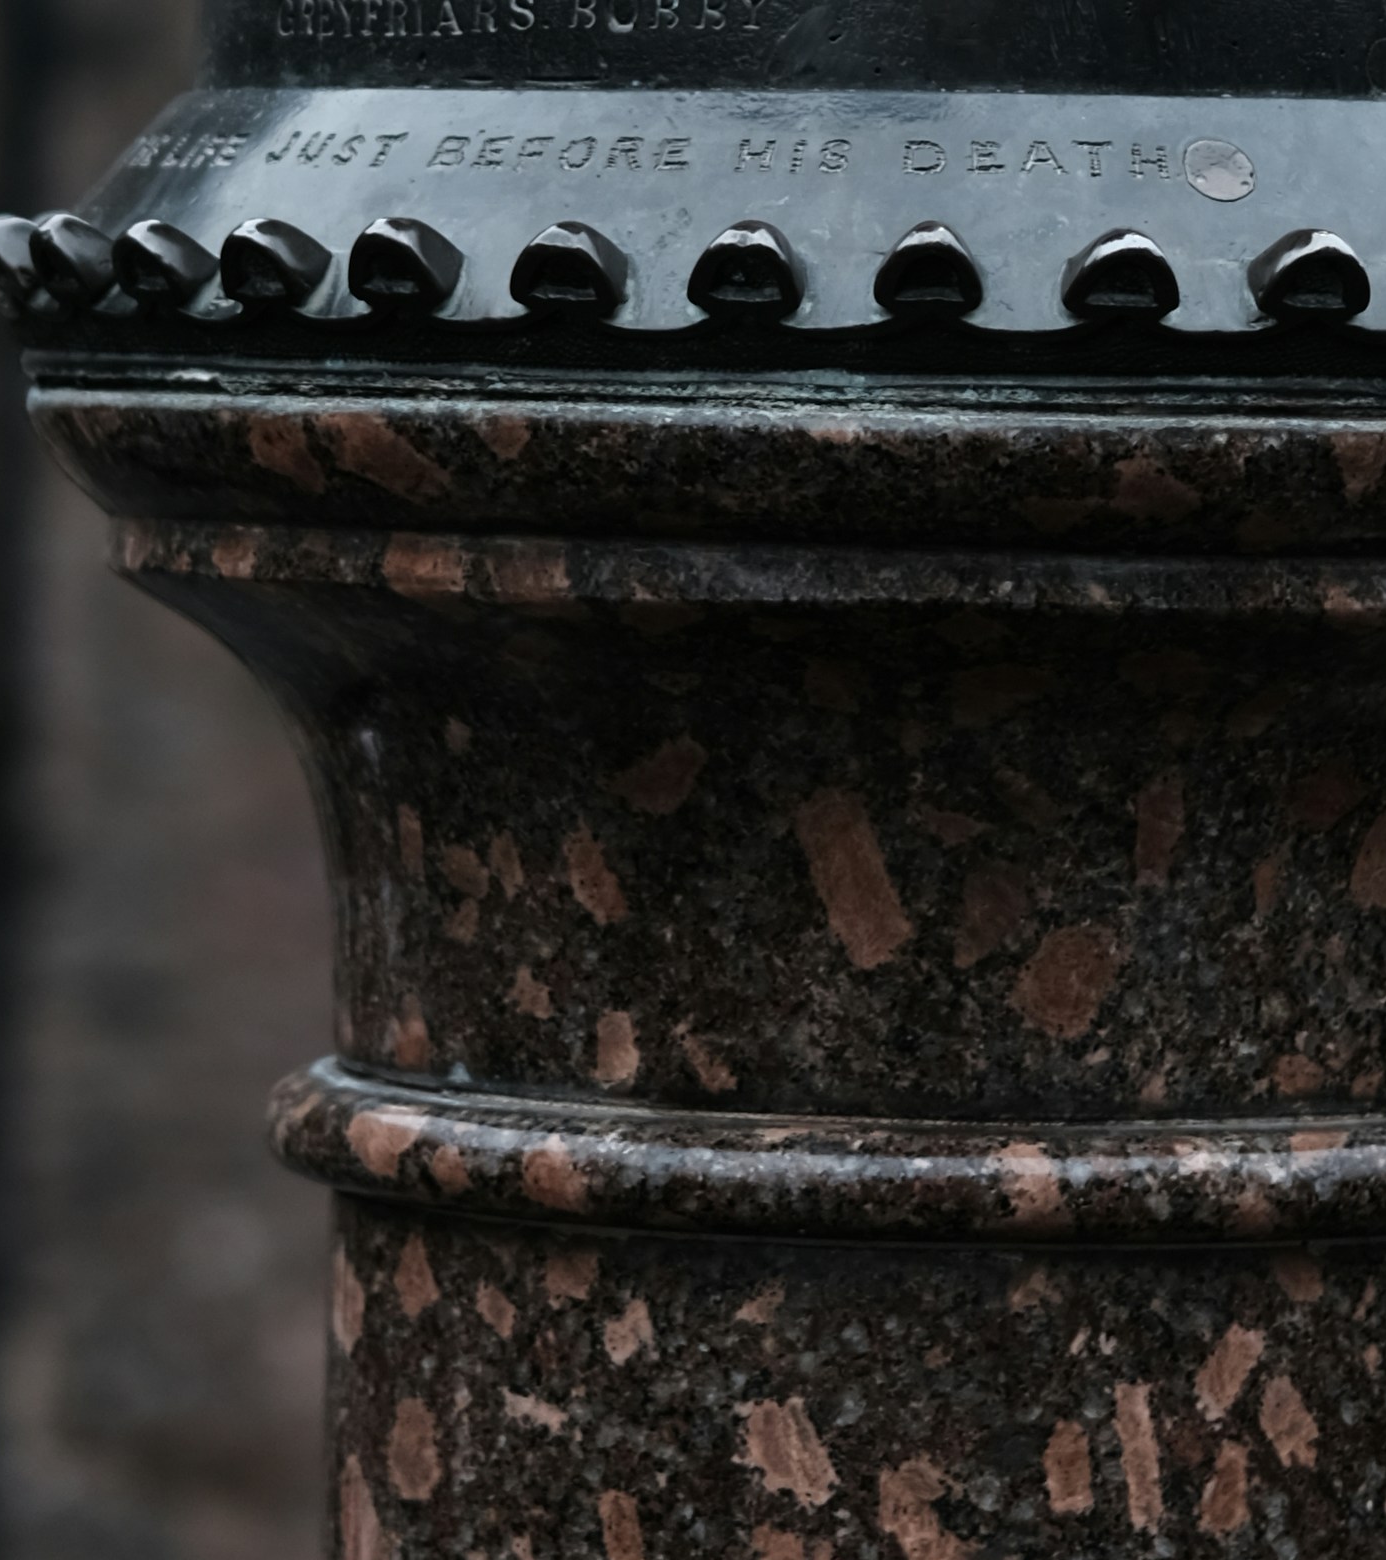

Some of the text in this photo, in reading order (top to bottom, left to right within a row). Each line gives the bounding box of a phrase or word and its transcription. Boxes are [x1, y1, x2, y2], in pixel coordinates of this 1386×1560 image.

[264, 129, 410, 168] JUST
[425, 134, 693, 173] BEFORE
[733, 136, 853, 175] HIS
[900, 139, 1173, 181] DEATH
